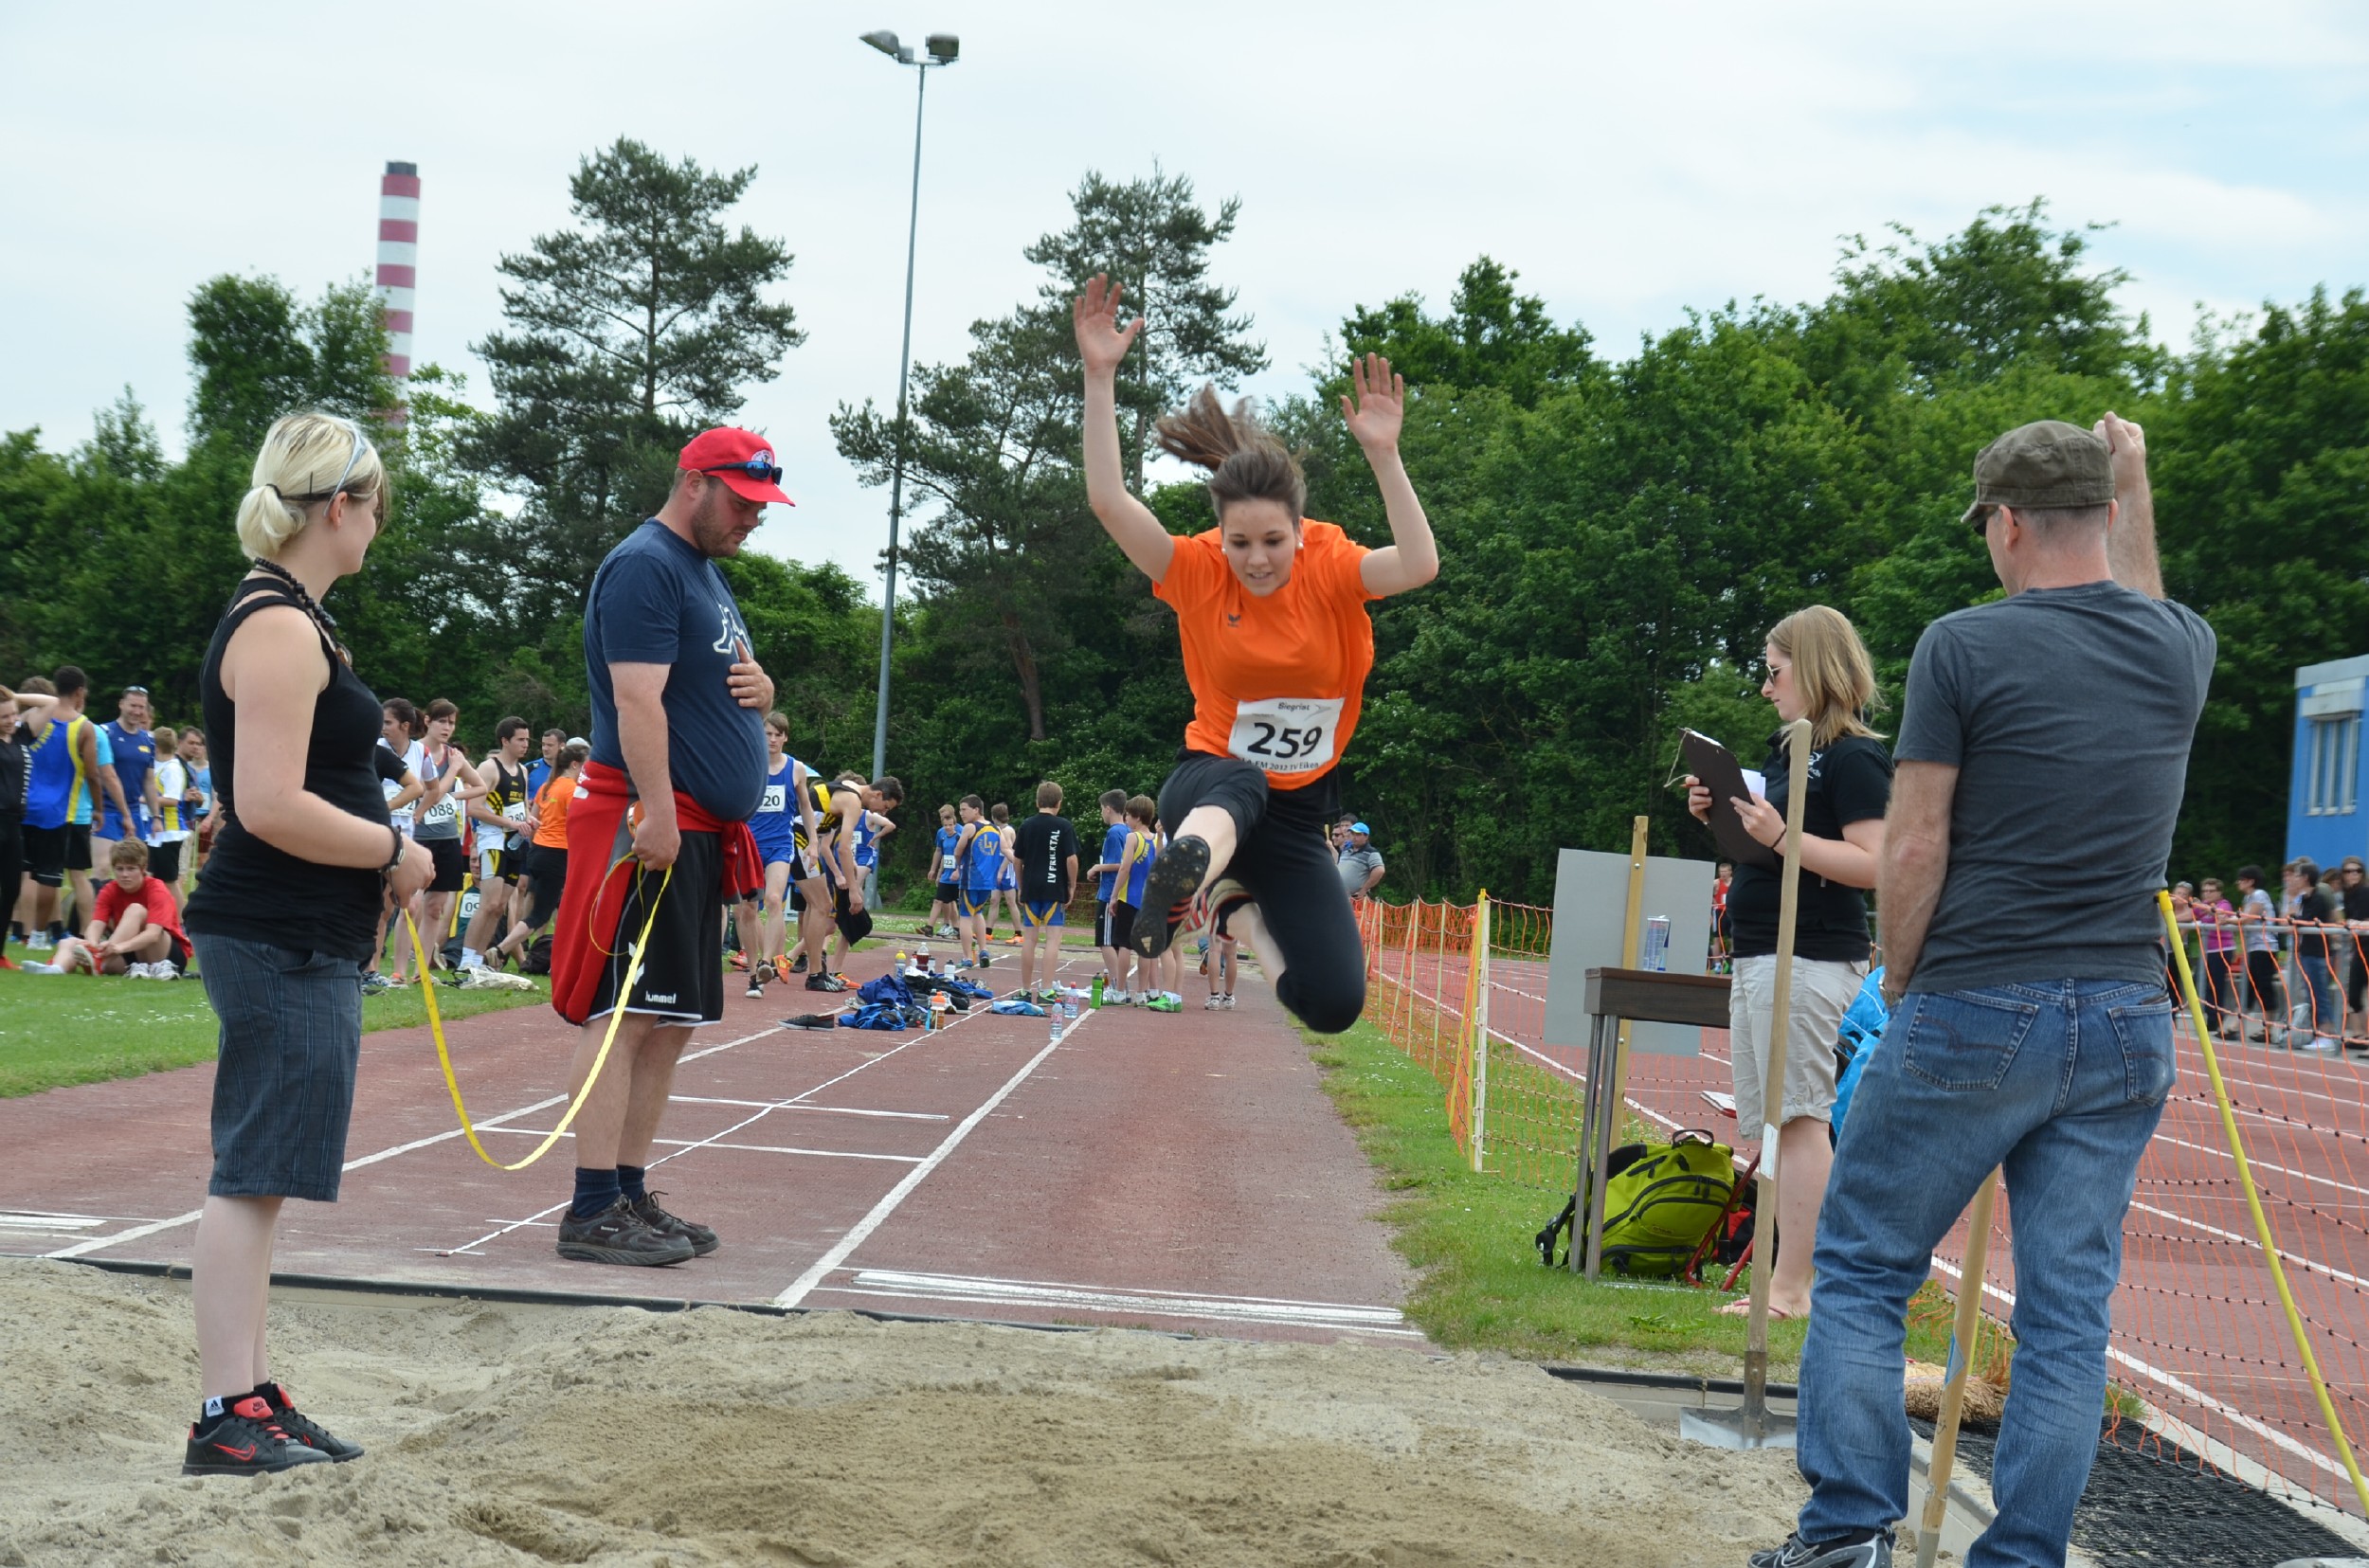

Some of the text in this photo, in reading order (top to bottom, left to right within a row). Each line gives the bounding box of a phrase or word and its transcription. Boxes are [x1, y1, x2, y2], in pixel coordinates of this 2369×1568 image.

[1247, 722, 1323, 759] 259
[429, 802, 455, 818] 088
[1047, 872, 1057, 884] LV
